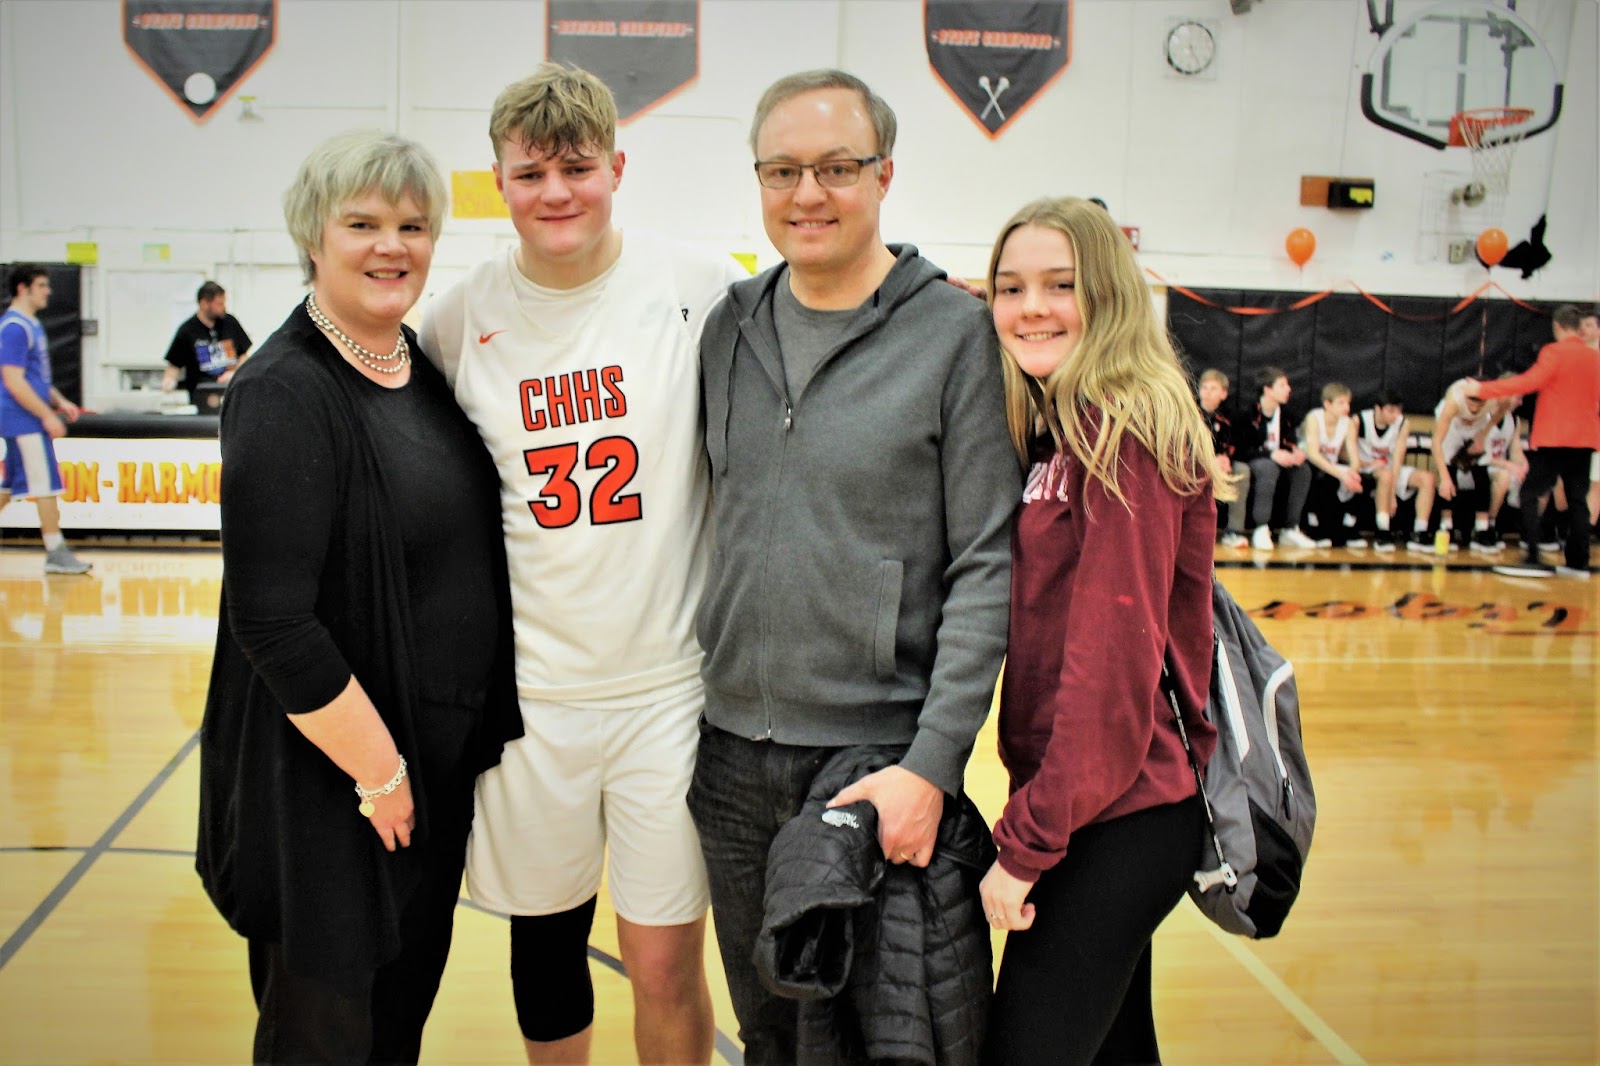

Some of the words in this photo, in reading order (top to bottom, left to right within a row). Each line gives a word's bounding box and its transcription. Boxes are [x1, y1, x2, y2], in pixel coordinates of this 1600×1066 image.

[519, 365, 627, 432] CHHS
[58, 461, 222, 503] ON-HARMO
[523, 435, 643, 529] 32
